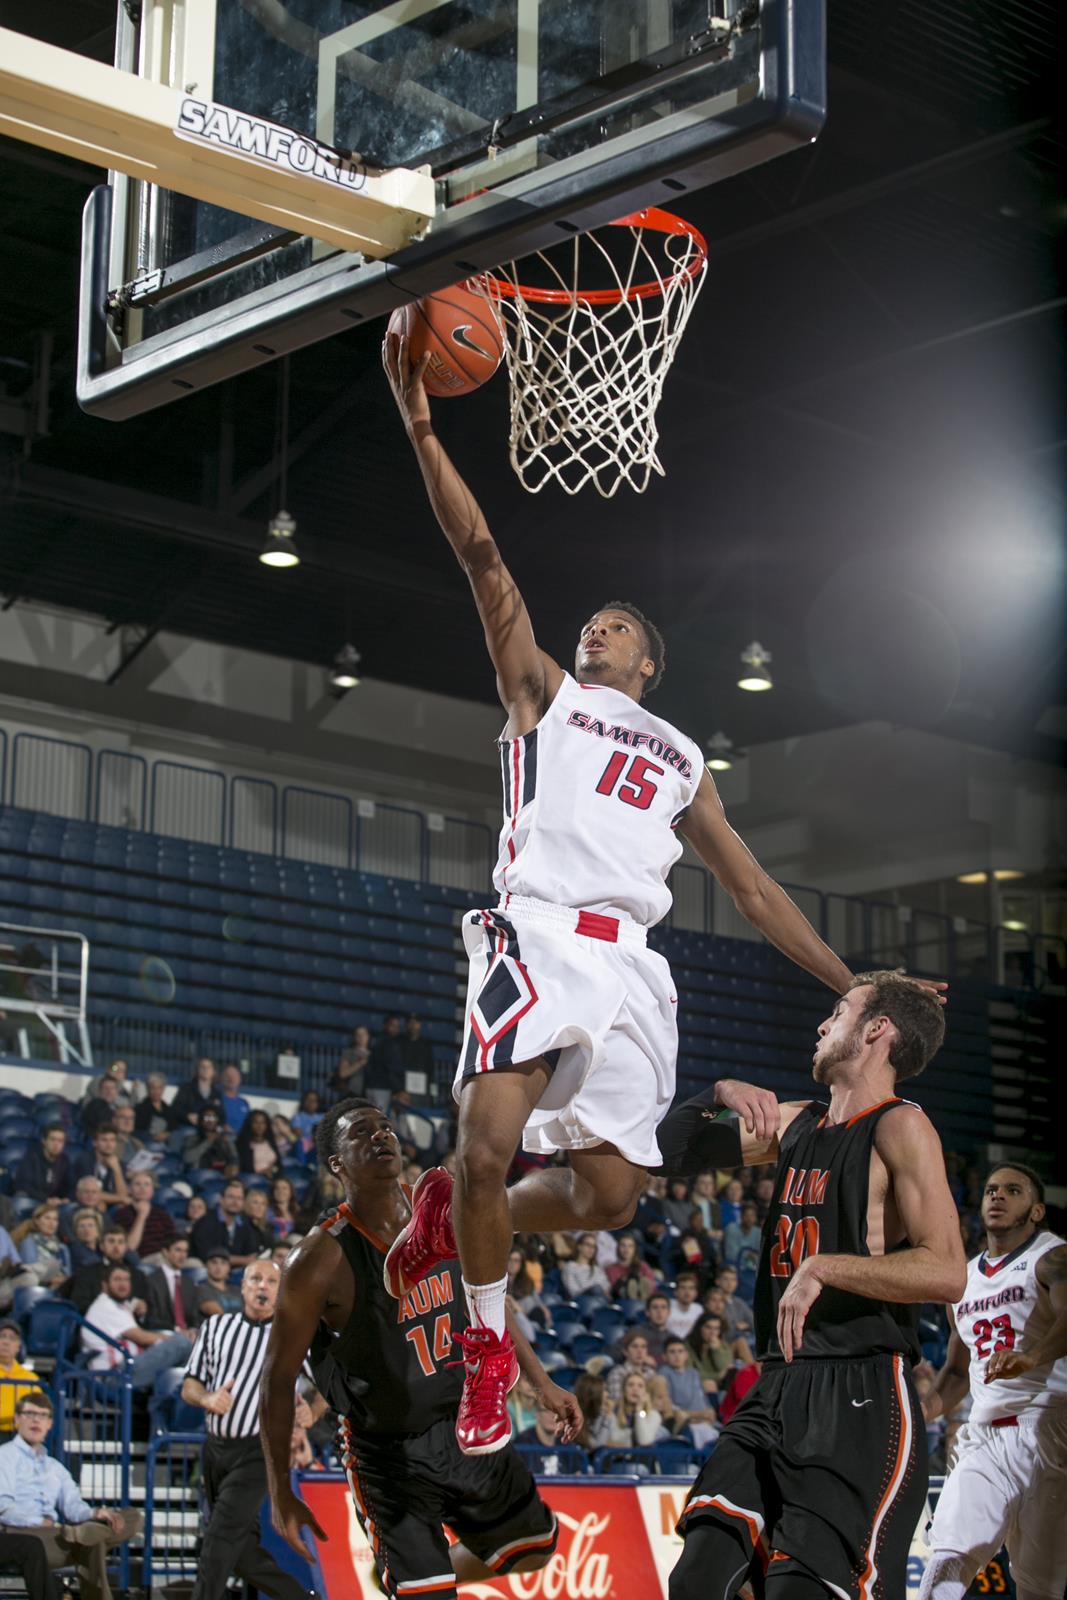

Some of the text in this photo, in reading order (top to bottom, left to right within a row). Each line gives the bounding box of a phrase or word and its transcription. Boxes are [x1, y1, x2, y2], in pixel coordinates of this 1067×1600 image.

[178, 98, 368, 190] SAMFORD
[566, 709, 692, 780] SAMFORD
[595, 750, 665, 810] 15
[770, 1214, 820, 1278] 20
[397, 1270, 454, 1325] AUM
[956, 1284, 1026, 1322] SAMFORD
[405, 1312, 453, 1377] 14
[972, 1313, 1016, 1361] 23
[507, 1511, 614, 1600] Cola
